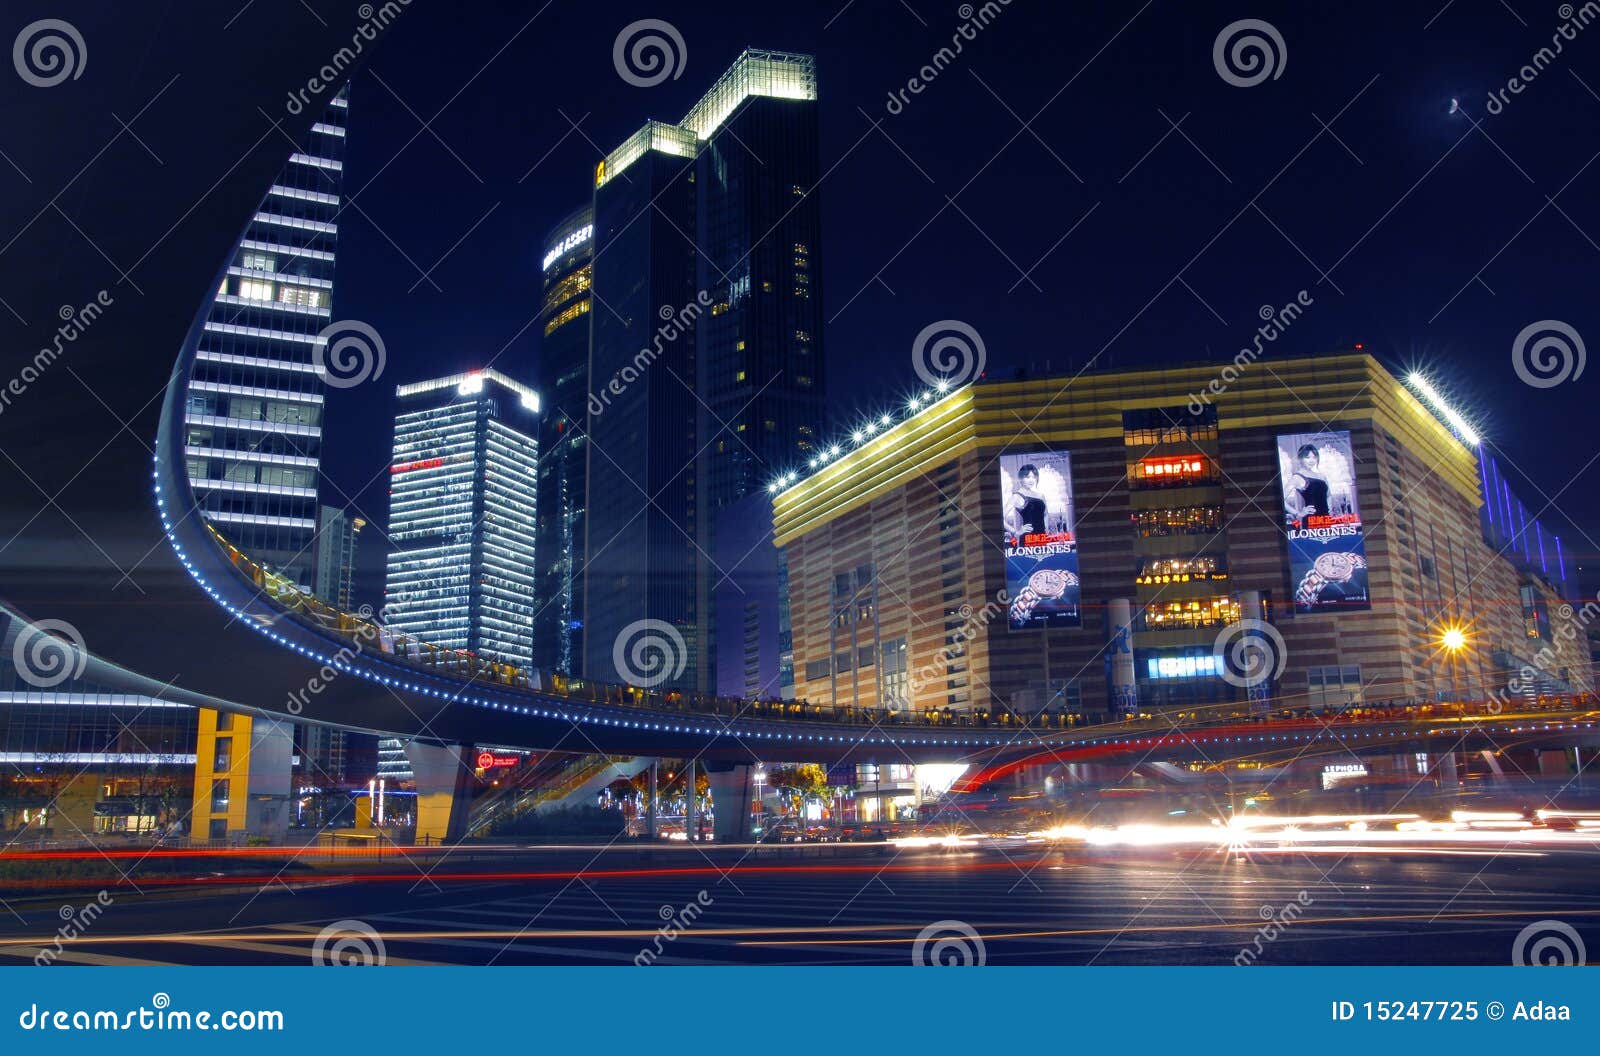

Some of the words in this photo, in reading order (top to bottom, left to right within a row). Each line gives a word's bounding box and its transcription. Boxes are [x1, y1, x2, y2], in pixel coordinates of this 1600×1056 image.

[1292, 526, 1357, 539] LONGINES
[1009, 544, 1071, 557] LONGINES
[1324, 764, 1365, 773] SEPHORA
